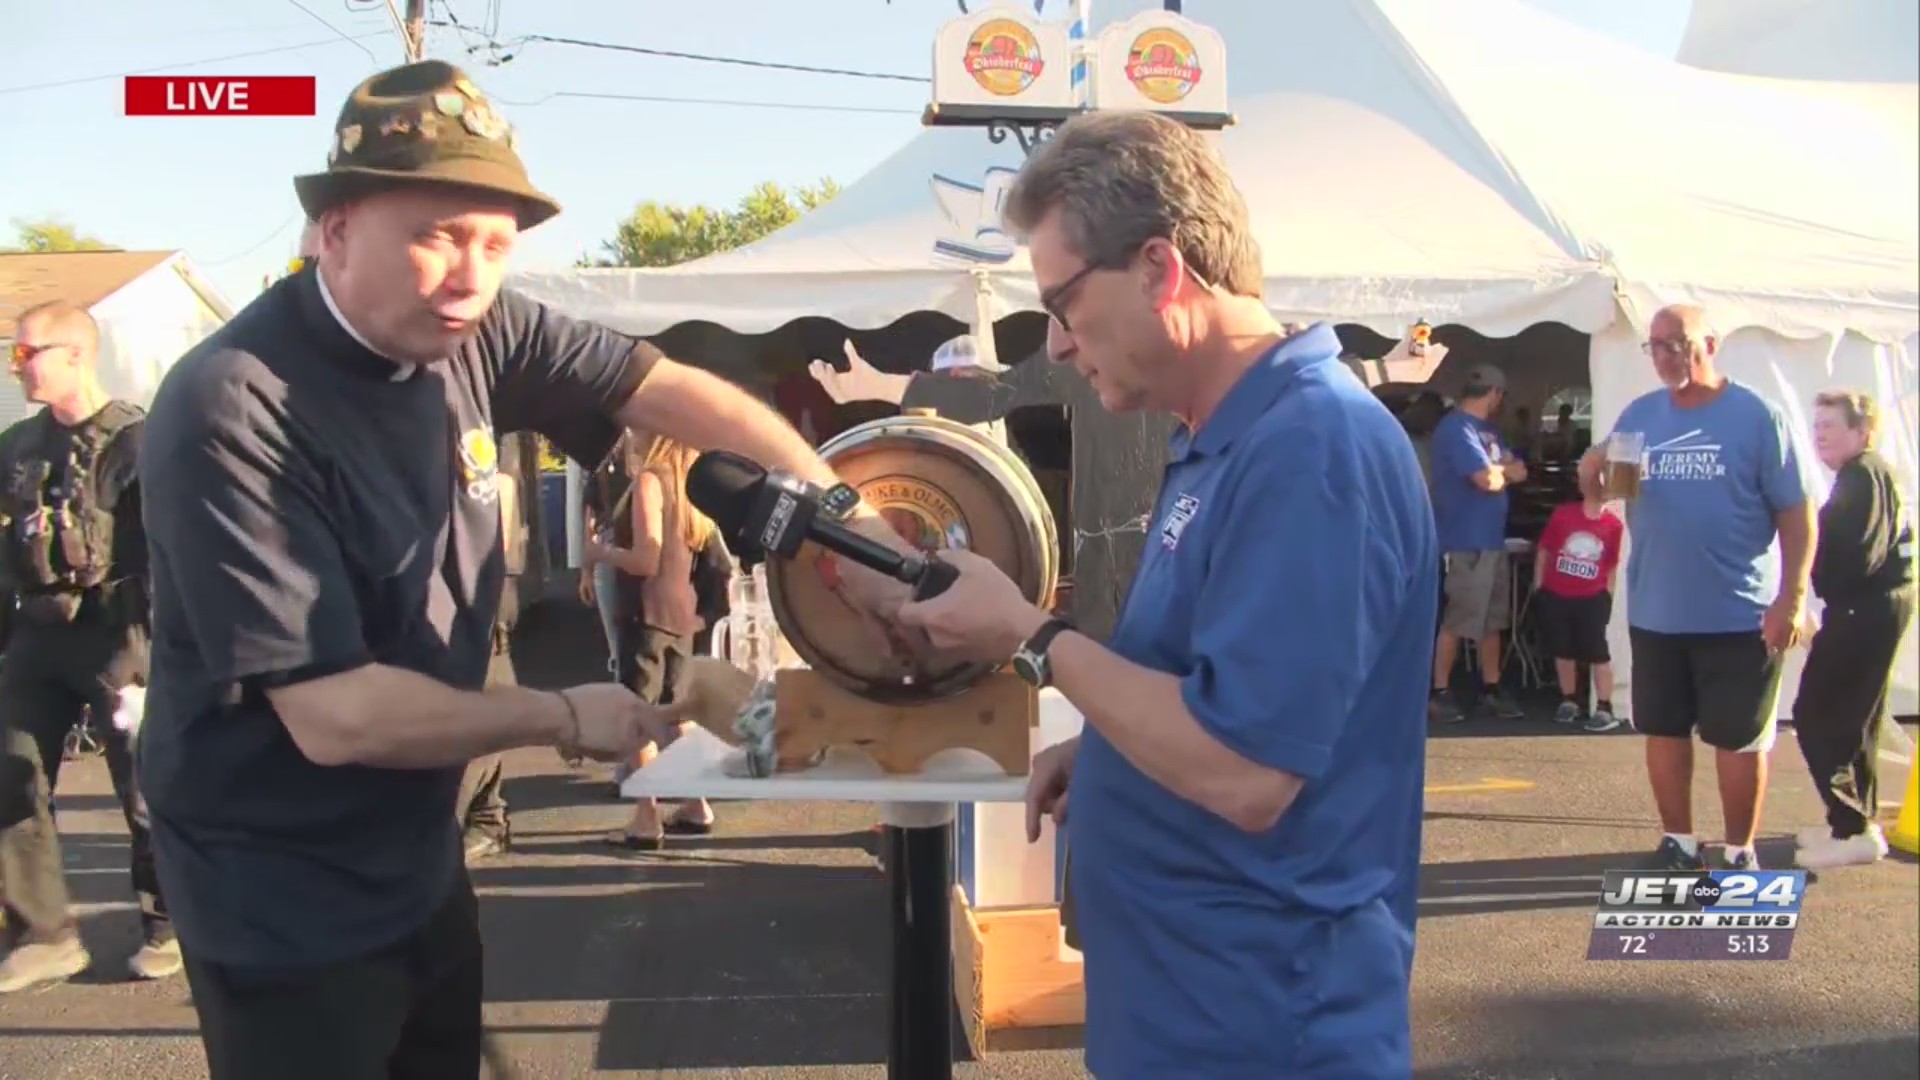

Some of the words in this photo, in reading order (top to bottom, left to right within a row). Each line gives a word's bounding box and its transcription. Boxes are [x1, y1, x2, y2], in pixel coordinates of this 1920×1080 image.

[1660, 452, 1719, 464] JEREMY
[1649, 463, 1726, 476] LIGHTNER
[1558, 558, 1598, 578] BISON
